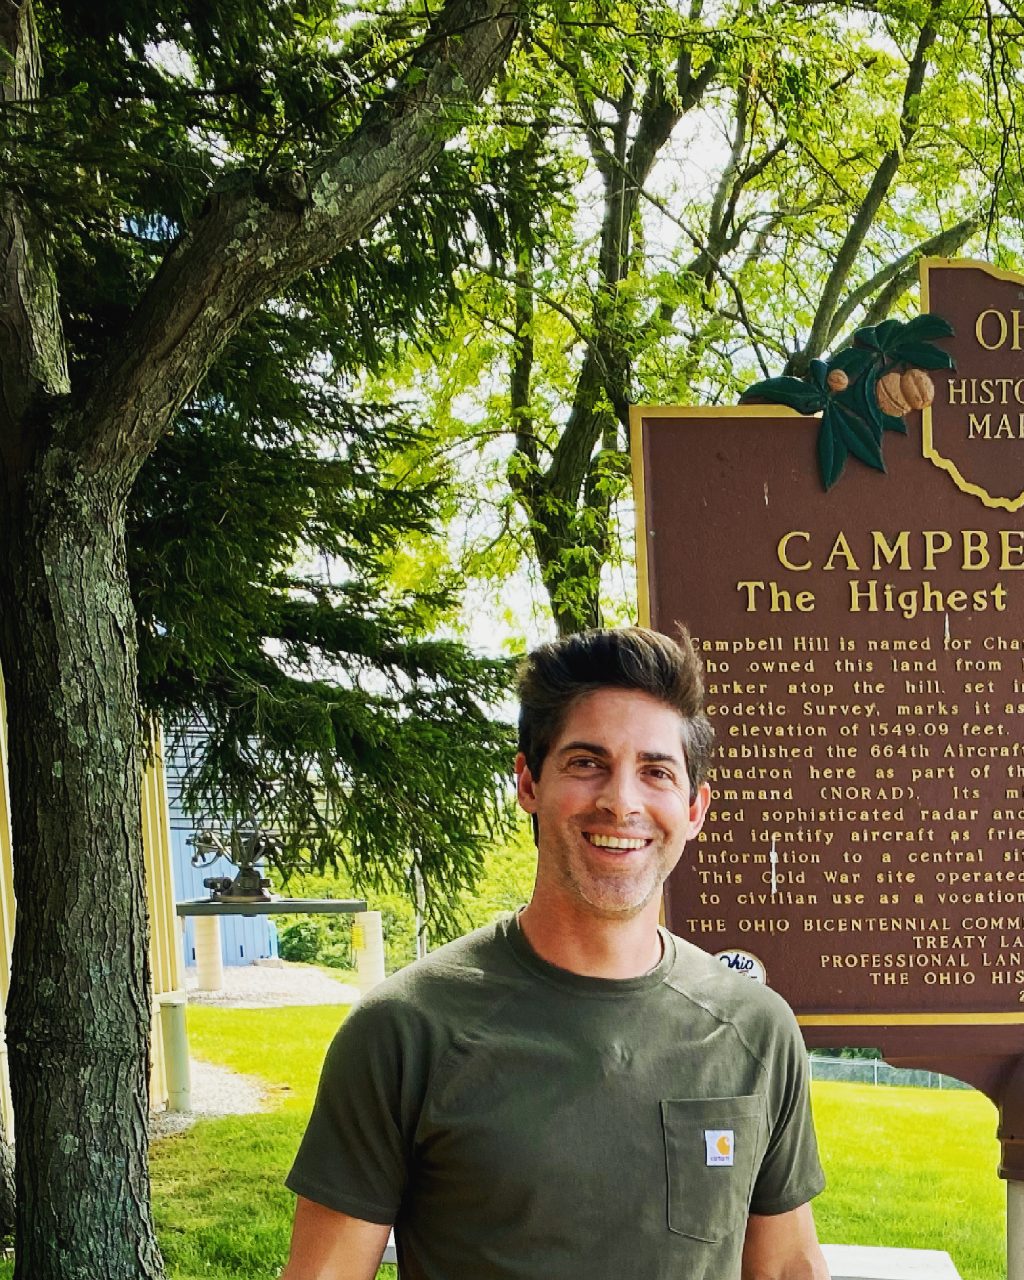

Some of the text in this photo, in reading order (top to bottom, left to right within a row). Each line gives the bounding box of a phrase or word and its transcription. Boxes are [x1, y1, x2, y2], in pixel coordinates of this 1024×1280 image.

[736, 581, 815, 612] The
[849, 580, 1008, 618] Highest
[793, 636, 829, 652] Hill
[839, 636, 855, 652] is
[867, 636, 931, 652] named
[943, 637, 972, 651] for
[705, 659, 730, 673] ho
[749, 659, 815, 673] owned
[834, 658, 874, 673] this
[892, 658, 937, 673] land
[955, 657, 1002, 672] from
[708, 680, 768, 694] arker
[788, 681, 834, 697] atop
[853, 680, 885, 694] the
[964, 680, 995, 693] set
[706, 701, 786, 717] eodetic
[803, 701, 880, 718] Survey,
[897, 700, 959, 716] marks
[975, 700, 991, 715] it
[1004, 703, 1024, 714] as
[729, 723, 828, 737] elevation
[839, 722, 859, 737] of
[870, 722, 949, 737] 1549.09
[962, 722, 1010, 736] feet.
[710, 743, 813, 759] tablished
[826, 744, 858, 758] the
[870, 743, 930, 758] 664th
[706, 765, 793, 782] quadron
[809, 764, 857, 779] here
[875, 768, 895, 779] as
[911, 765, 955, 782] part
[970, 764, 990, 779] of
[711, 785, 794, 801] ommand
[820, 786, 921, 801] (NORAD).
[953, 786, 980, 800] Its
[709, 807, 745, 822] sed
[761, 807, 904, 824] sophisticated
[918, 807, 979, 822] radar
[698, 827, 734, 843] and
[750, 827, 834, 844] identify
[851, 827, 935, 843] aircraft
[950, 829, 970, 842] as
[843, 851, 863, 863] to
[881, 852, 892, 863] a
[908, 848, 983, 863] central
[698, 870, 743, 884] This
[761, 870, 806, 885] Cold
[823, 870, 861, 884] War
[876, 870, 916, 884] site
[699, 891, 721, 905] to
[737, 891, 818, 905] civilian
[832, 894, 865, 905] use
[879, 894, 899, 905] as
[914, 893, 924, 905] a
[686, 919, 727, 933] THE
[738, 919, 790, 933] OHIO
[803, 917, 951, 933] BICENTENNIAL
[912, 935, 988, 950] TREATY
[820, 953, 970, 968] PROFESSIONAL
[869, 972, 909, 985] THE
[923, 971, 976, 985] OHIO
